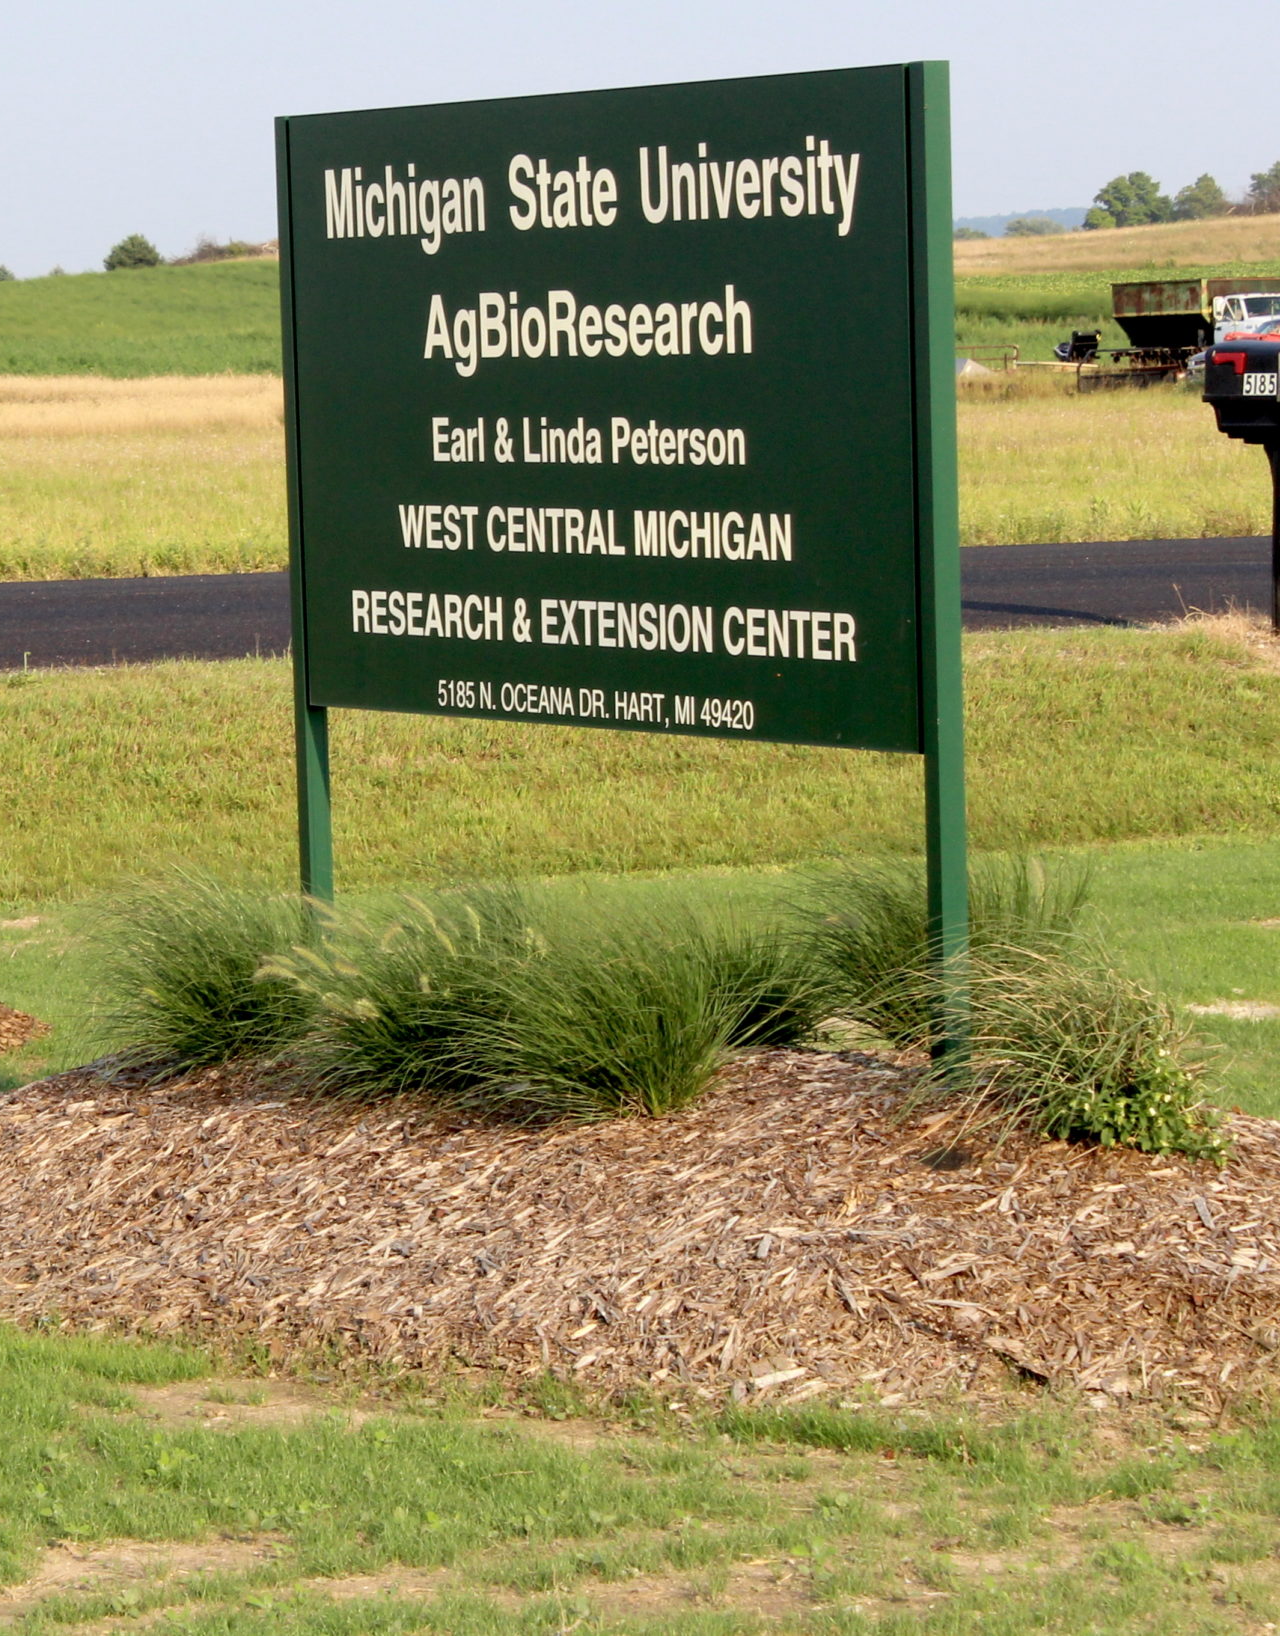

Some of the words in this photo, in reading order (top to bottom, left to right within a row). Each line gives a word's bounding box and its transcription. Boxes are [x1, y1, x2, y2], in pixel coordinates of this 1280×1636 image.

[324, 163, 486, 255] Michigan
[508, 153, 618, 231] State
[639, 135, 861, 237] University
[423, 284, 752, 378] AgBioResearch
[1245, 375, 1276, 394] 5185
[431, 416, 485, 463] Earl
[494, 417, 515, 464] &
[522, 416, 603, 465] Linda
[611, 416, 746, 466] Peterson
[398, 504, 479, 551] WEST
[486, 505, 626, 556] CENTRAL
[633, 509, 792, 562] MICHIGAN
[351, 589, 503, 641] RESEARCH
[512, 597, 533, 643] &
[540, 598, 713, 653] EXTENSION
[722, 606, 857, 662] CENTER
[437, 679, 476, 709] 5185
[479, 681, 497, 711] N.
[500, 682, 575, 716] OCEANA
[579, 688, 610, 719] DR.
[614, 690, 669, 729] HART,
[674, 694, 695, 726] MI
[700, 697, 754, 731] 49420
